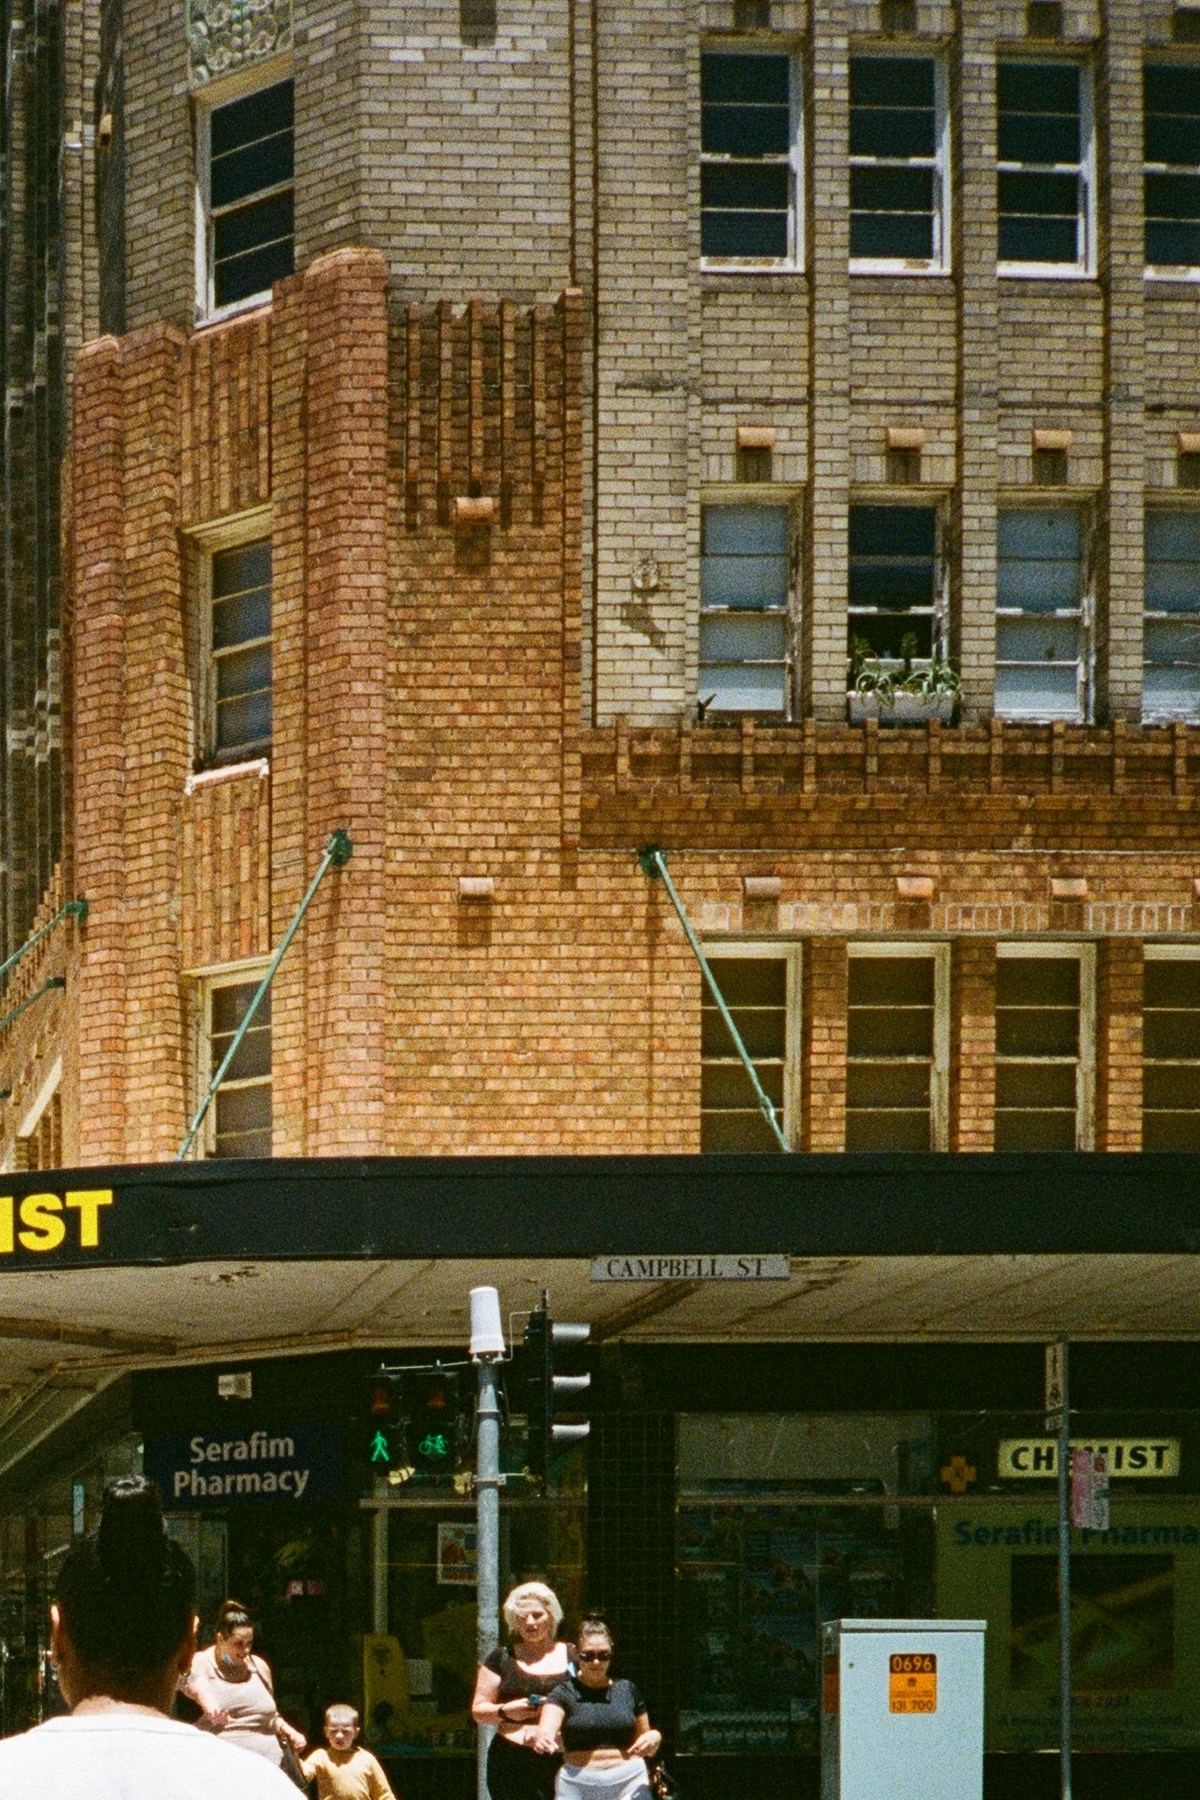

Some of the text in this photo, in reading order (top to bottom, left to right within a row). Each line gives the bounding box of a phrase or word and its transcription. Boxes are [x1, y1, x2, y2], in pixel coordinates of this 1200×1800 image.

[607, 1257, 766, 1277] CAMPBELL ST
[190, 1431, 295, 1463] Serafim
[1010, 1446, 1170, 1470] CHIST
[174, 1469, 309, 1499] Pharmacy
[893, 1656, 932, 1671] 0696
